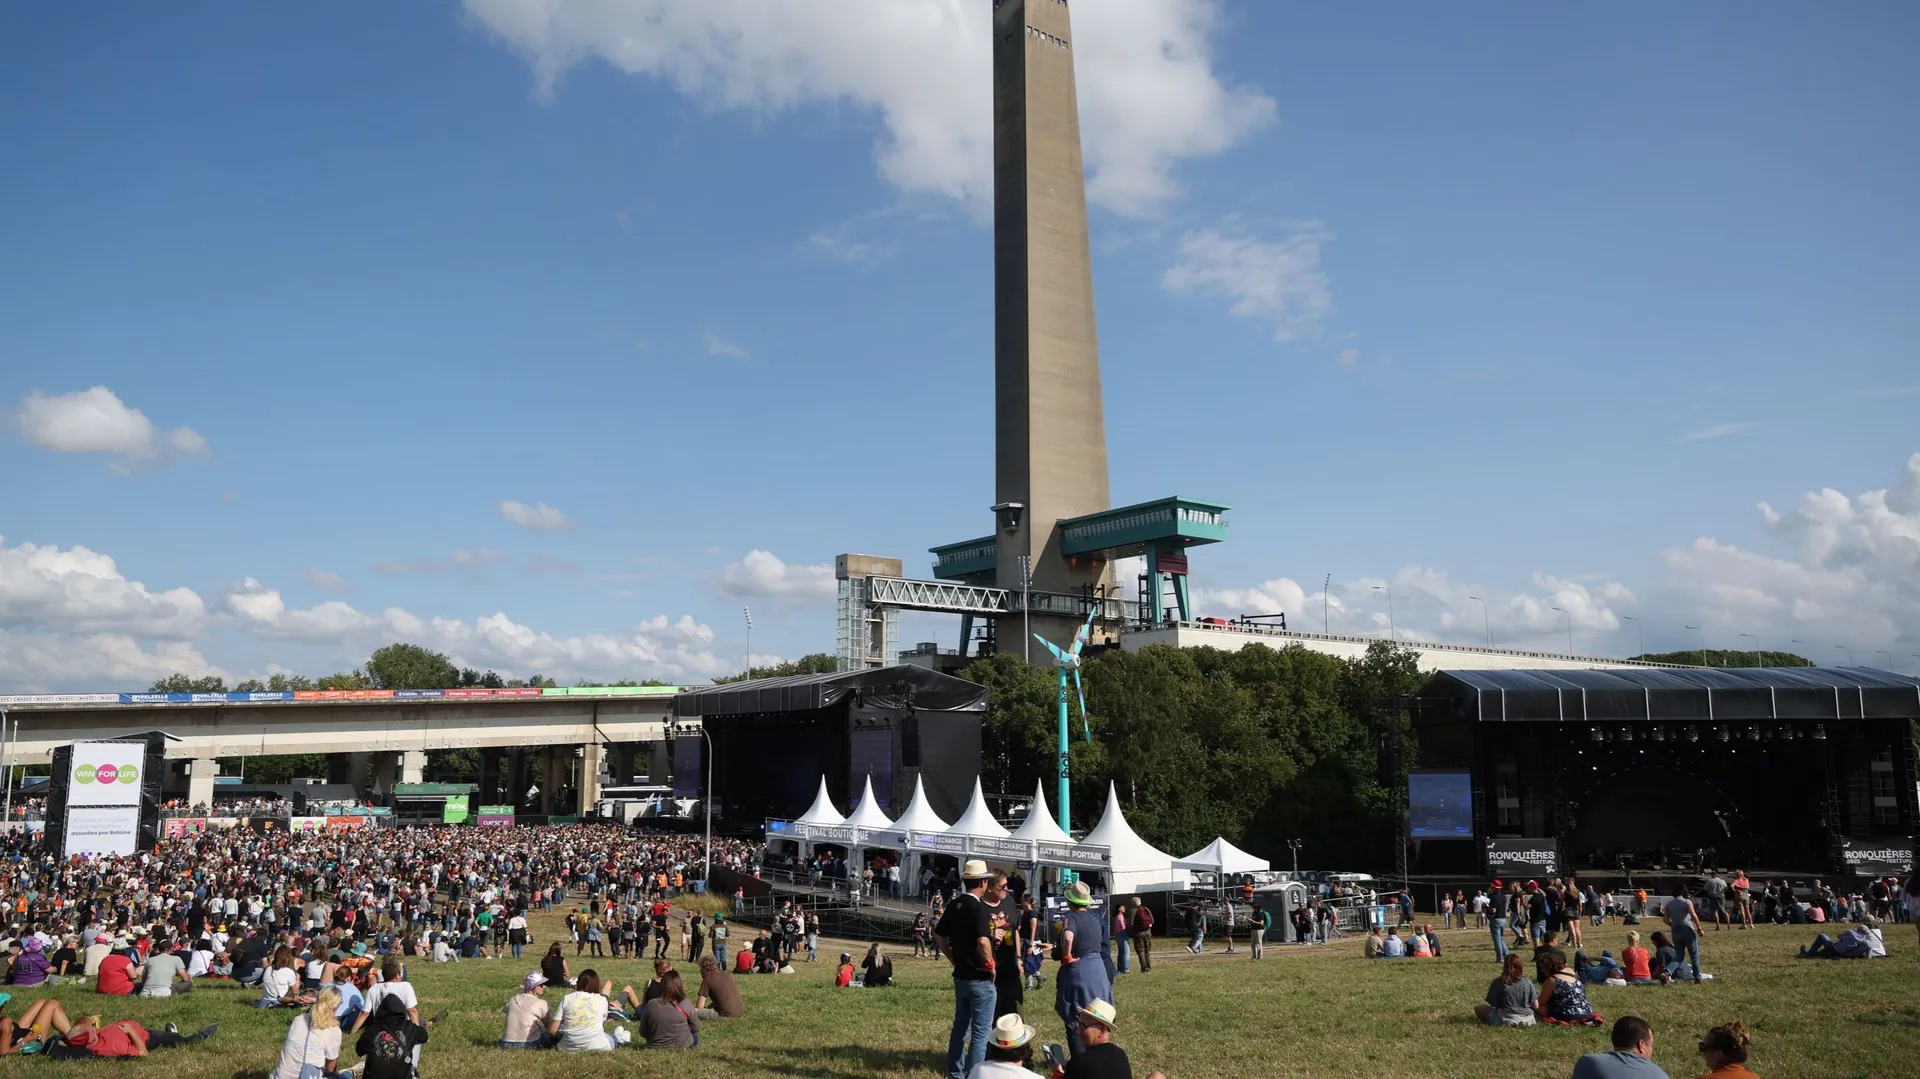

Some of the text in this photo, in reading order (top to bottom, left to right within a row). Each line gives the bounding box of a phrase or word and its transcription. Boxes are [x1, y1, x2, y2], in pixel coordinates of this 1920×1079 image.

[1060, 751, 1069, 778] Bolt
[795, 825, 826, 837] FESTIVAL
[974, 840, 995, 848] BORNES
[1072, 851, 1104, 860] PORTABL
[1489, 849, 1555, 861] RONQUIÈRES
[1845, 848, 1912, 860] RONQUIÈRES
